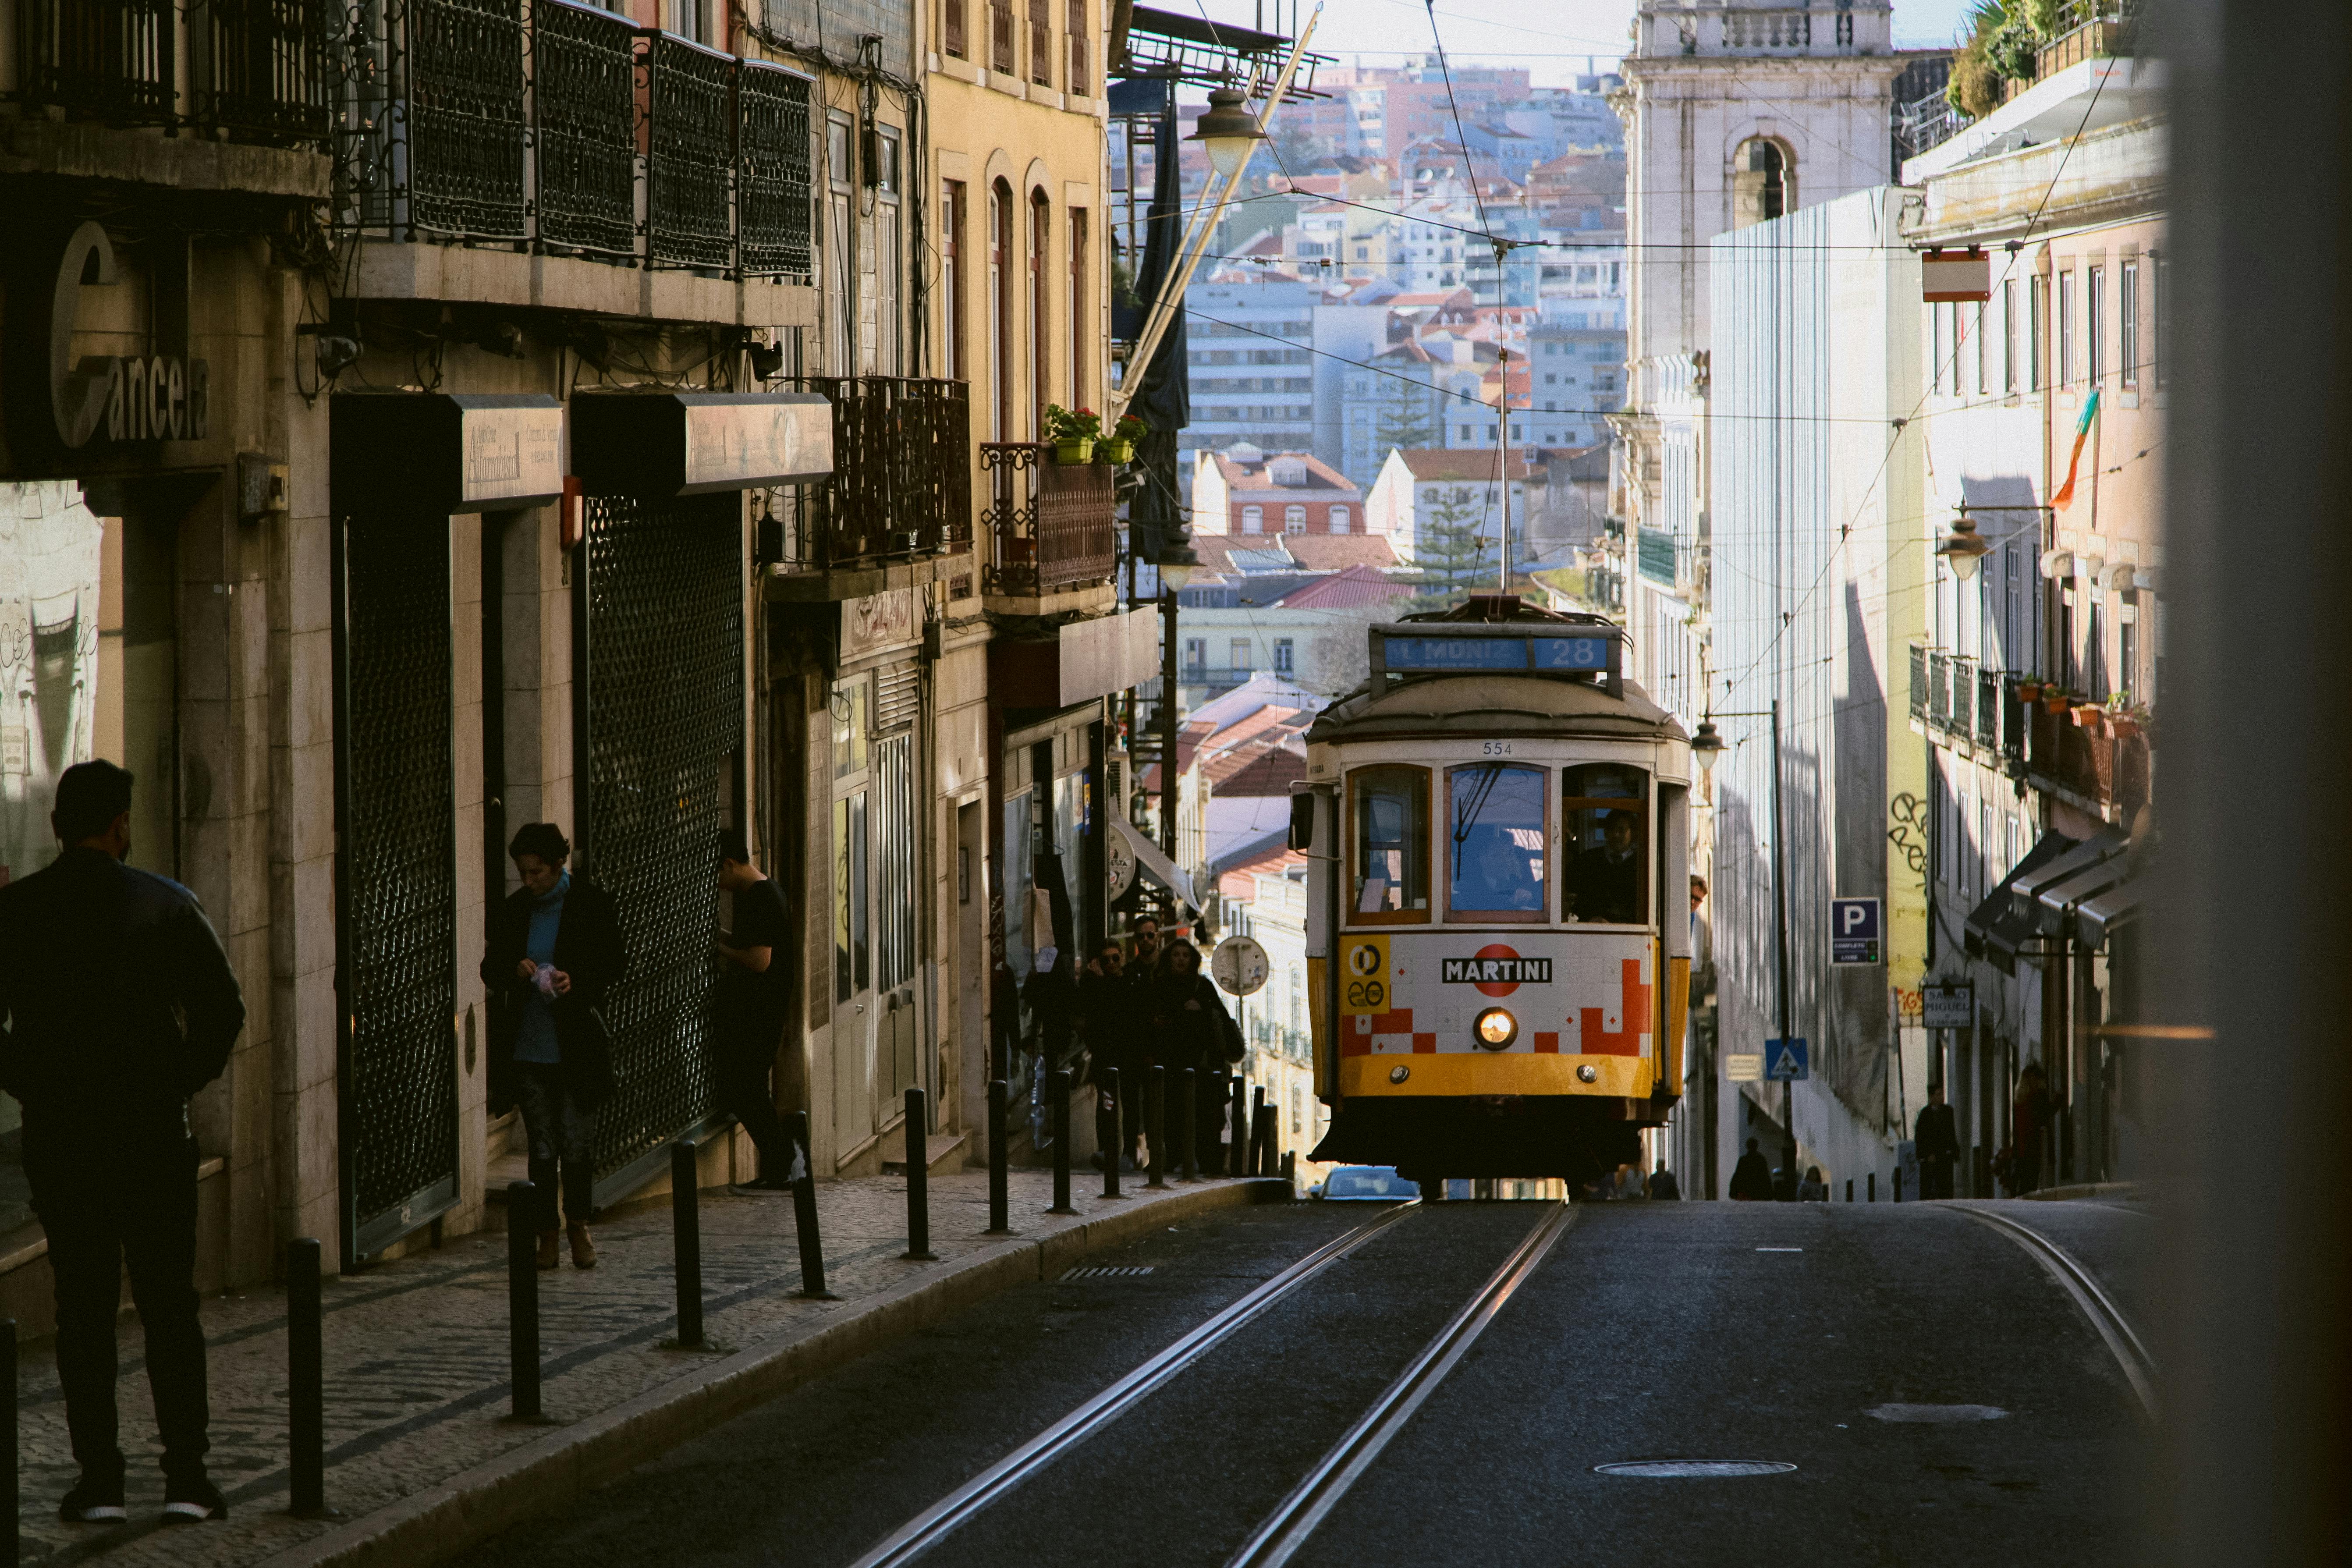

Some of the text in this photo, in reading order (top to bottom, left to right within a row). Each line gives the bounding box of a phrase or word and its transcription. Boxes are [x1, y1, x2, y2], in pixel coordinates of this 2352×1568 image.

[1553, 639, 1594, 665] 28
[1483, 742, 1511, 755] 554
[1844, 905, 1866, 934] P
[1447, 961, 1548, 980] MARTINI
